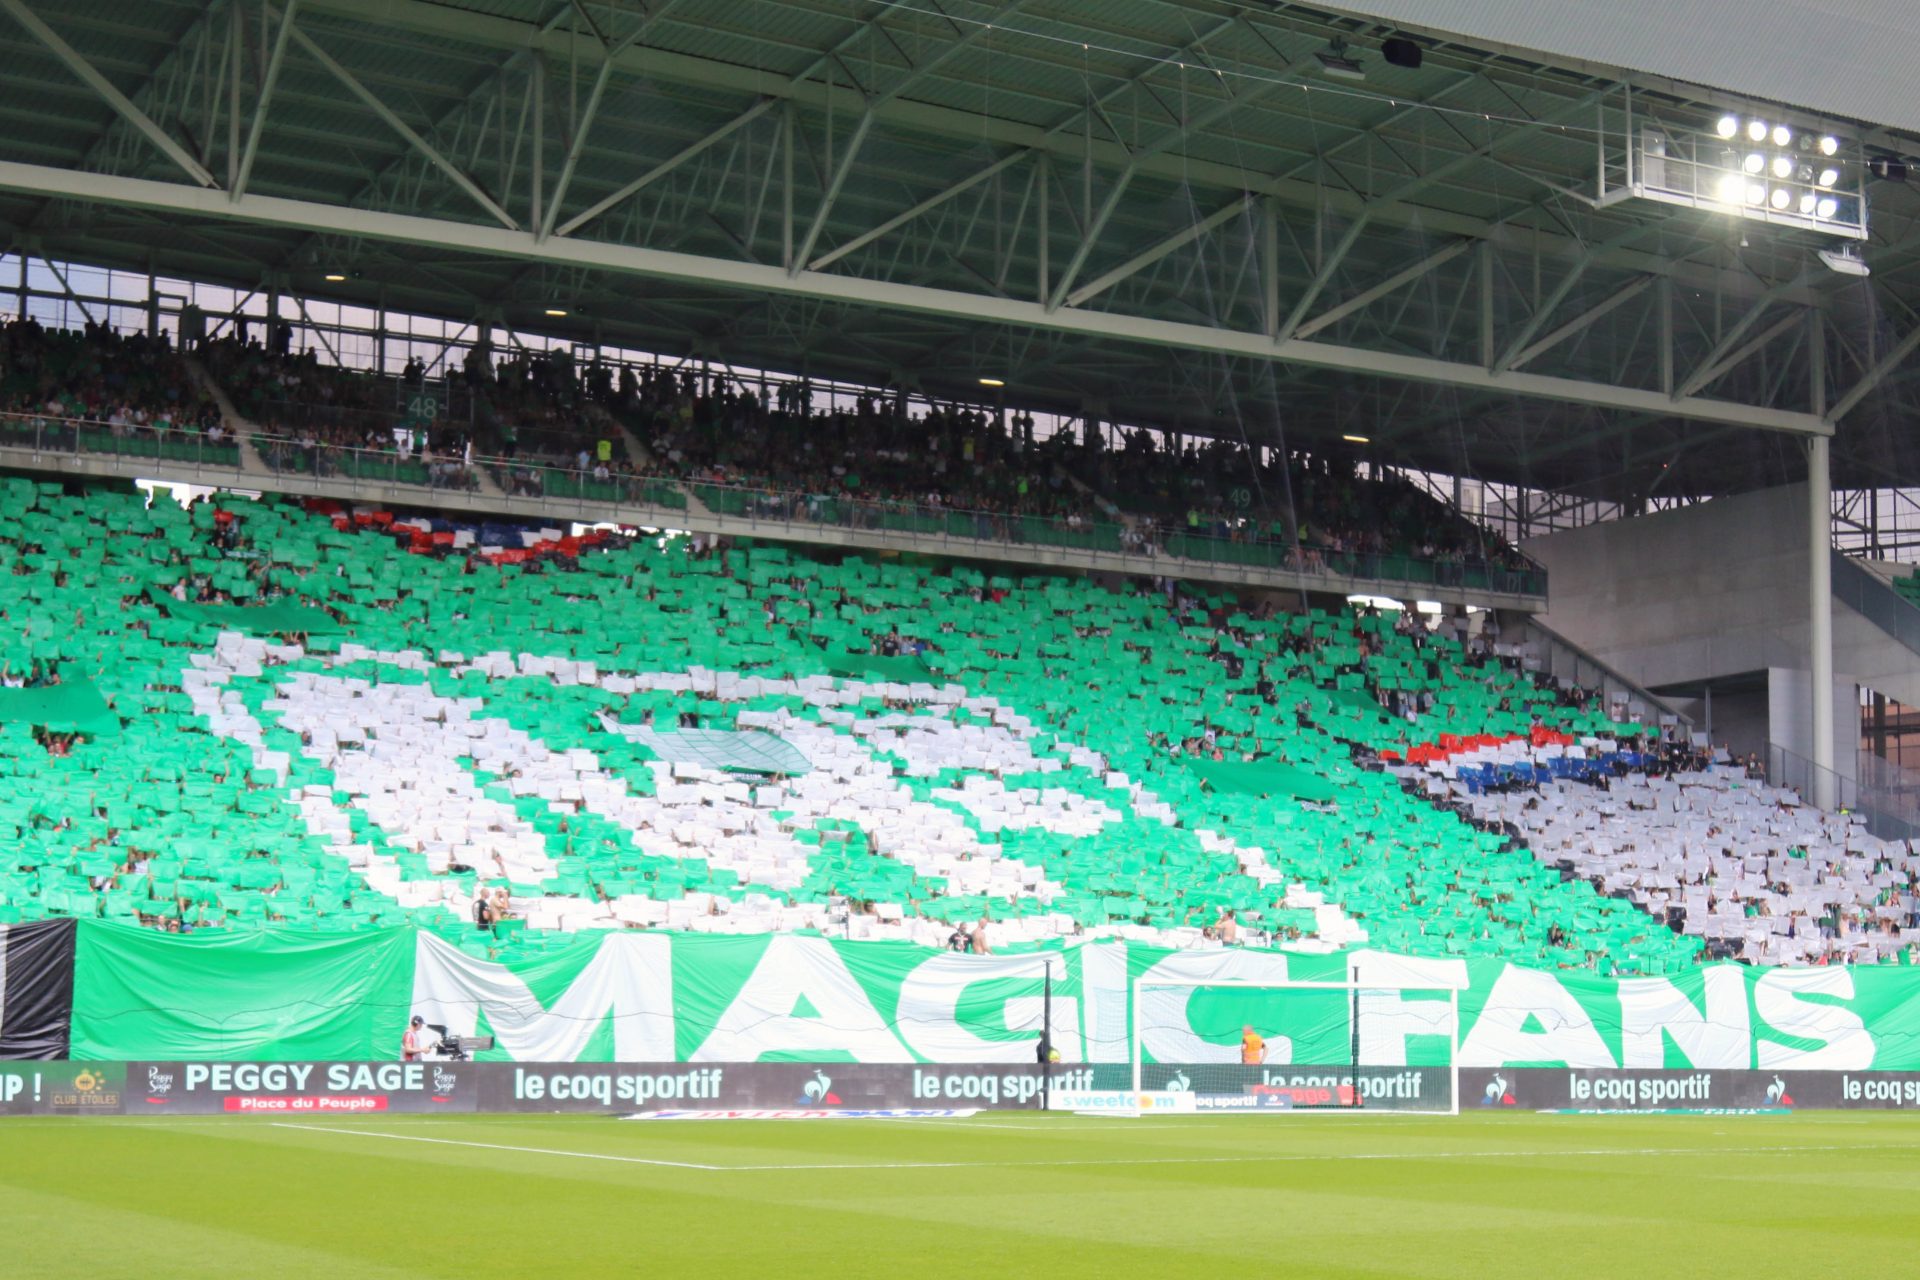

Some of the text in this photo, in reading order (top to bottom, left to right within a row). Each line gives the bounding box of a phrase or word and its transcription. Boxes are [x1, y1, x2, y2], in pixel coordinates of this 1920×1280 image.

[408, 397, 437, 418] 48
[1230, 488, 1251, 507] 49
[411, 930, 1876, 1072] MAGIC FANS
[186, 1064, 424, 1091] PEGGY SAGE
[515, 1068, 722, 1105] le coq sportif
[913, 1069, 940, 1098] le
[944, 1075, 998, 1104] coq
[1570, 1073, 1711, 1104] le coq sportif
[1843, 1075, 1862, 1100] le
[1864, 1080, 1902, 1105] coq
[240, 1098, 376, 1110] Place du Peuple
[1196, 1095, 1258, 1108] oq sportif
